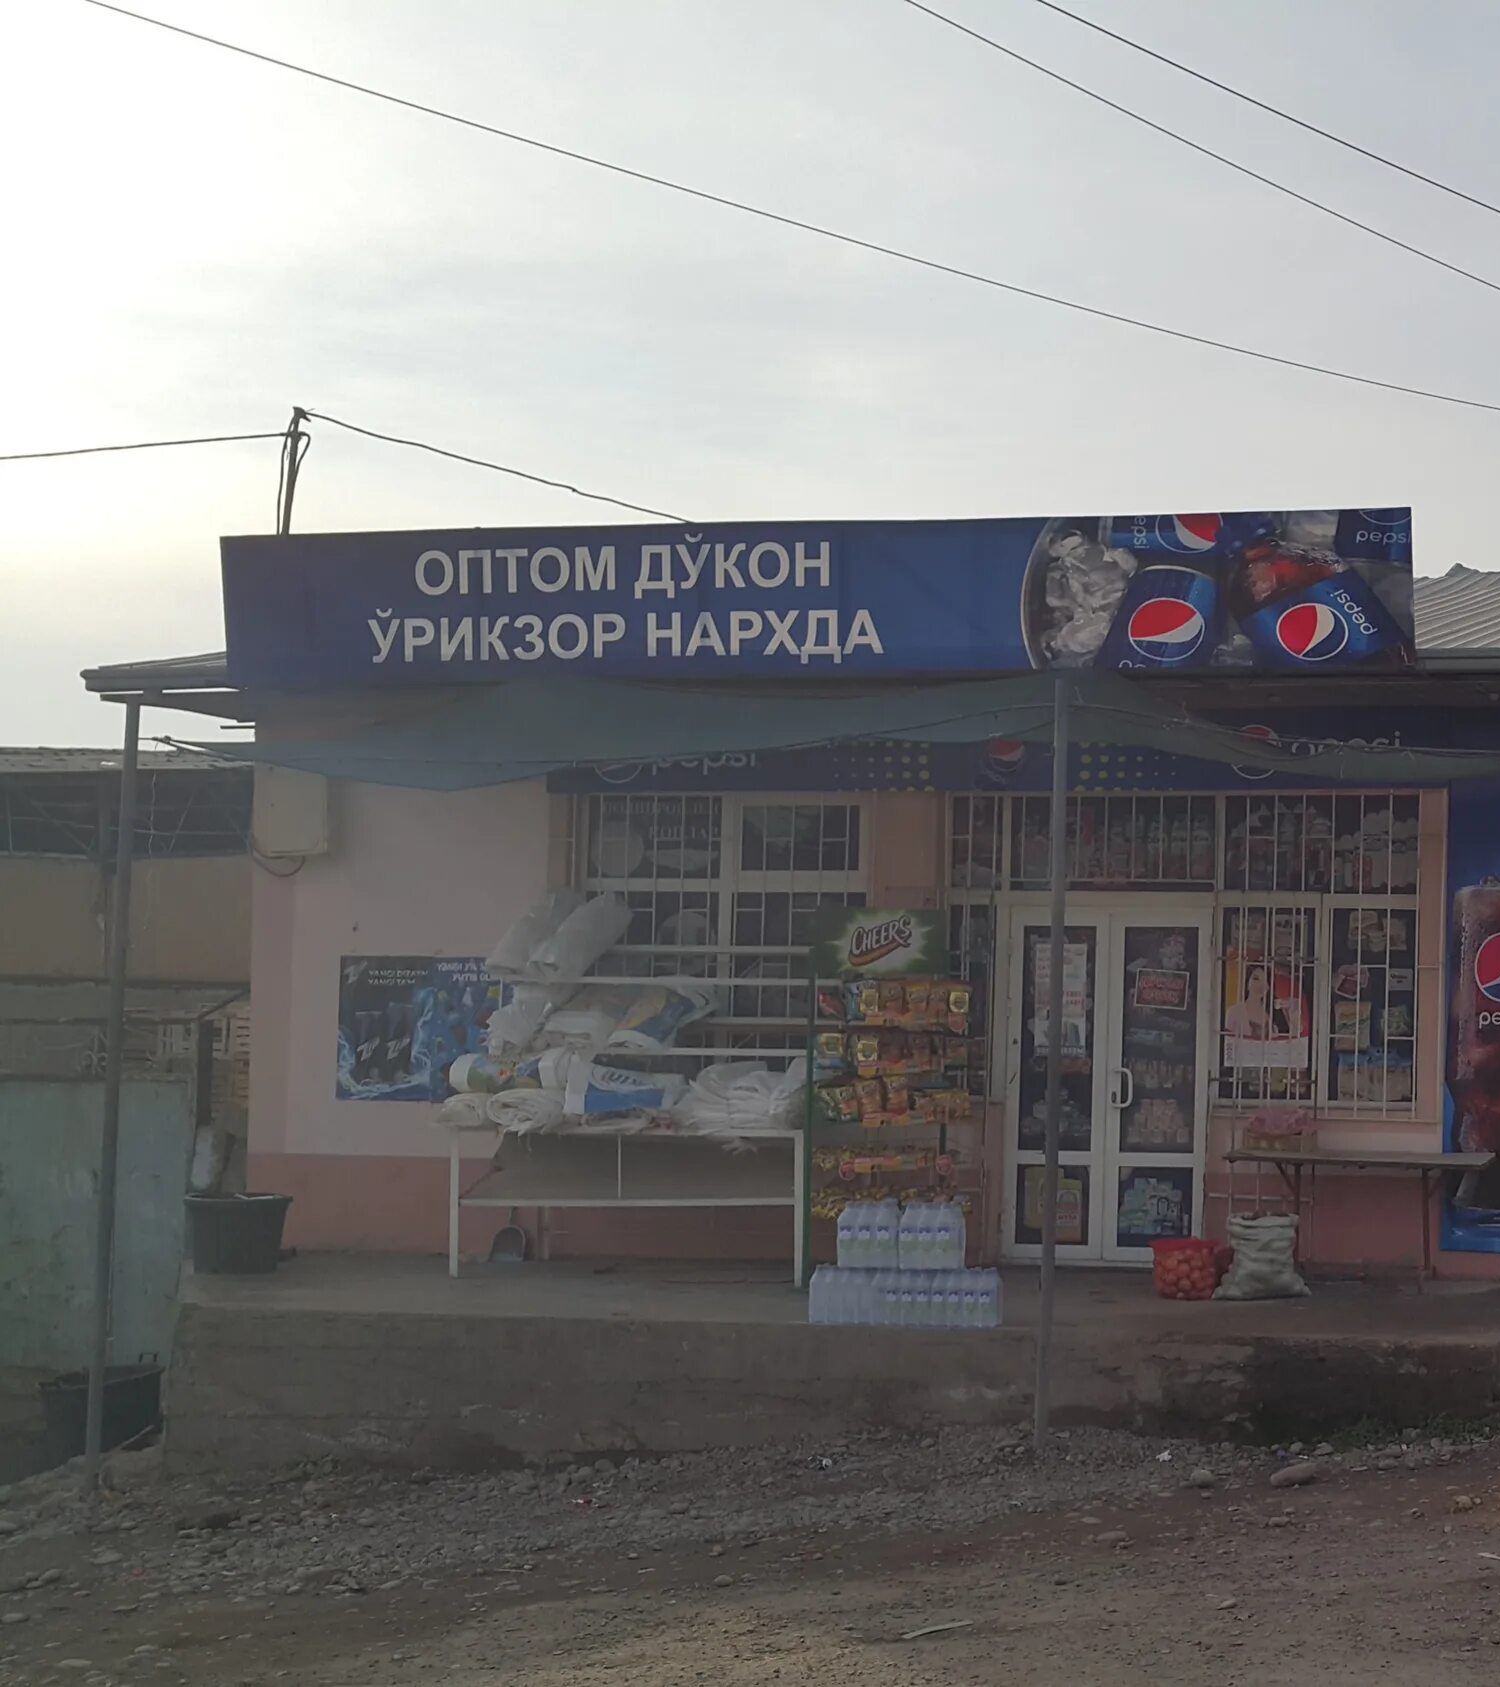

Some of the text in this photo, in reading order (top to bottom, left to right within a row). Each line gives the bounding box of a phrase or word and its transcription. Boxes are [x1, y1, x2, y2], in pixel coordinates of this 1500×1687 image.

[1131, 515, 1150, 549] epsi
[413, 533, 831, 599] ОПТОМ ДЎКОН
[367, 607, 885, 664] ЎРИКЗОР НАРХДА
[1329, 588, 1379, 636] pepsi
[851, 914, 912, 955] CHEERS
